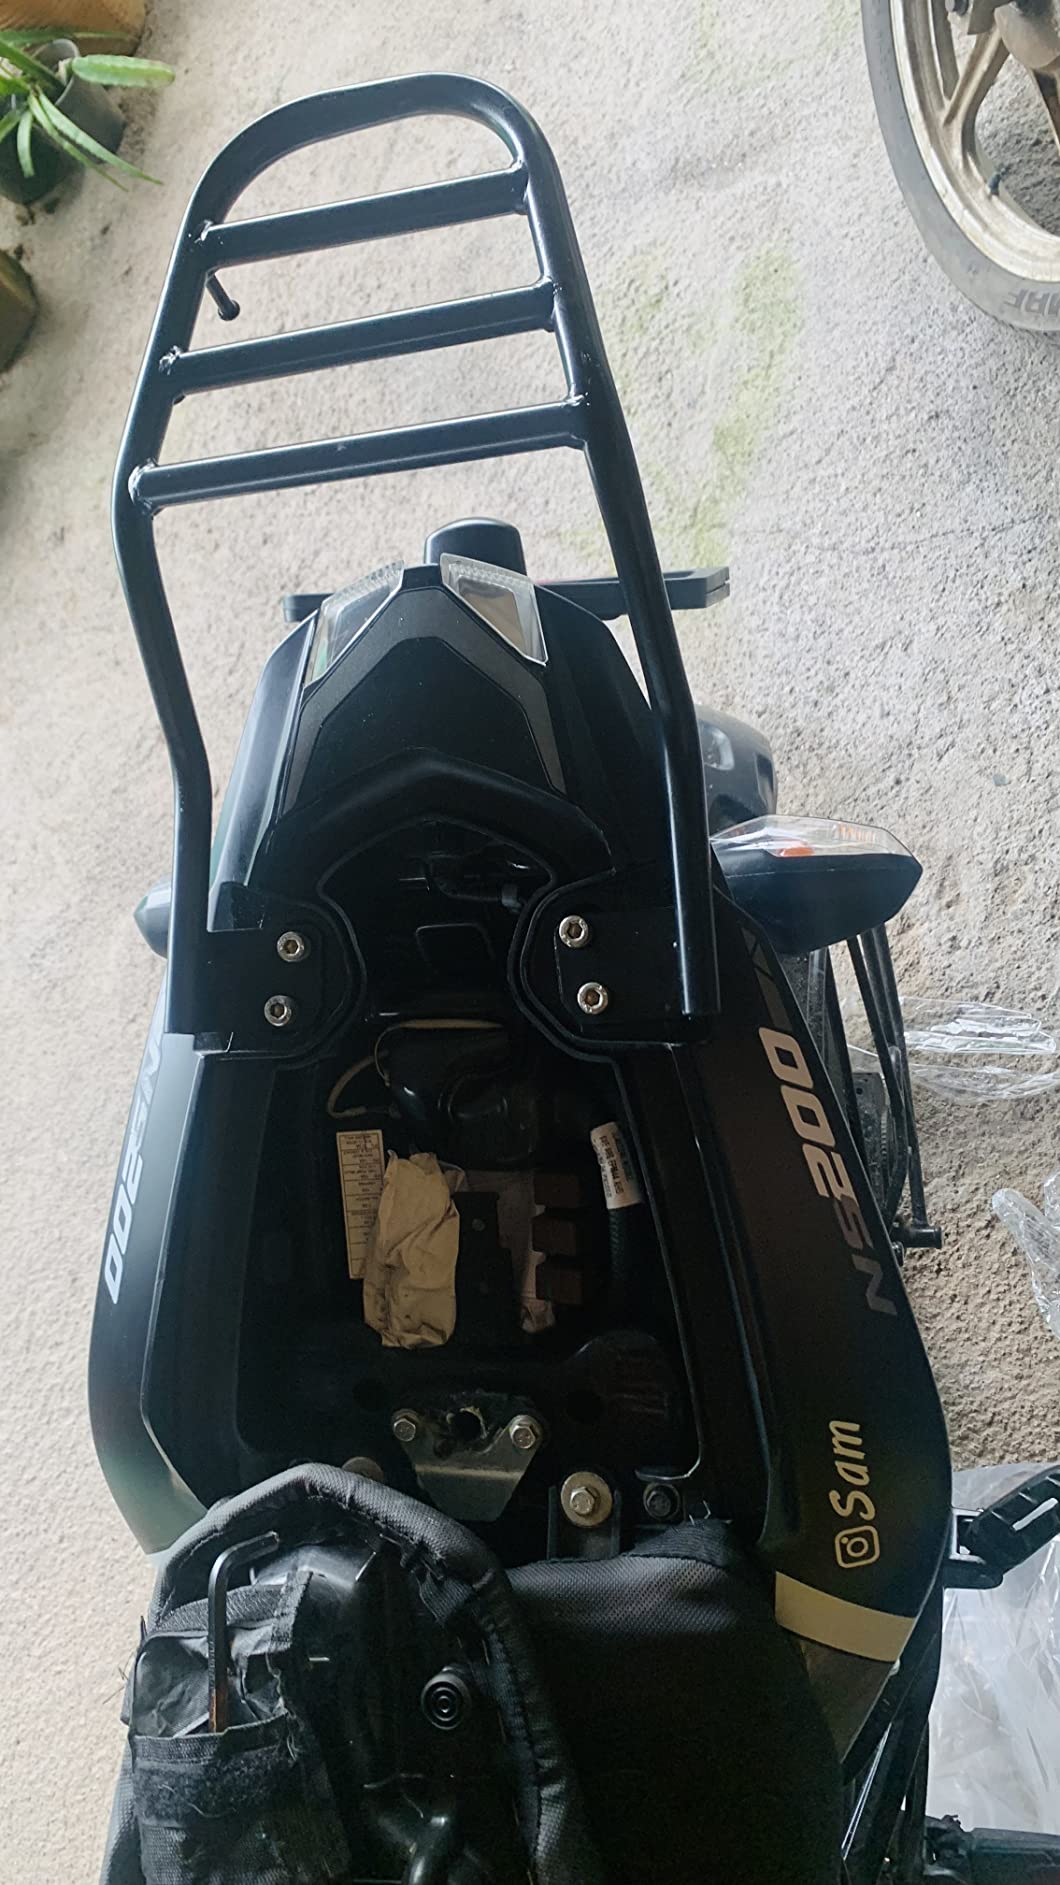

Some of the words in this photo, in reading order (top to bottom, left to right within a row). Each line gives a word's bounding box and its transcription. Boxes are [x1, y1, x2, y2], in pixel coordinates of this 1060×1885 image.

[104, 1034, 161, 1304] NS200
[757, 1026, 898, 1316] NS200
[828, 1420, 876, 1521] Sam
